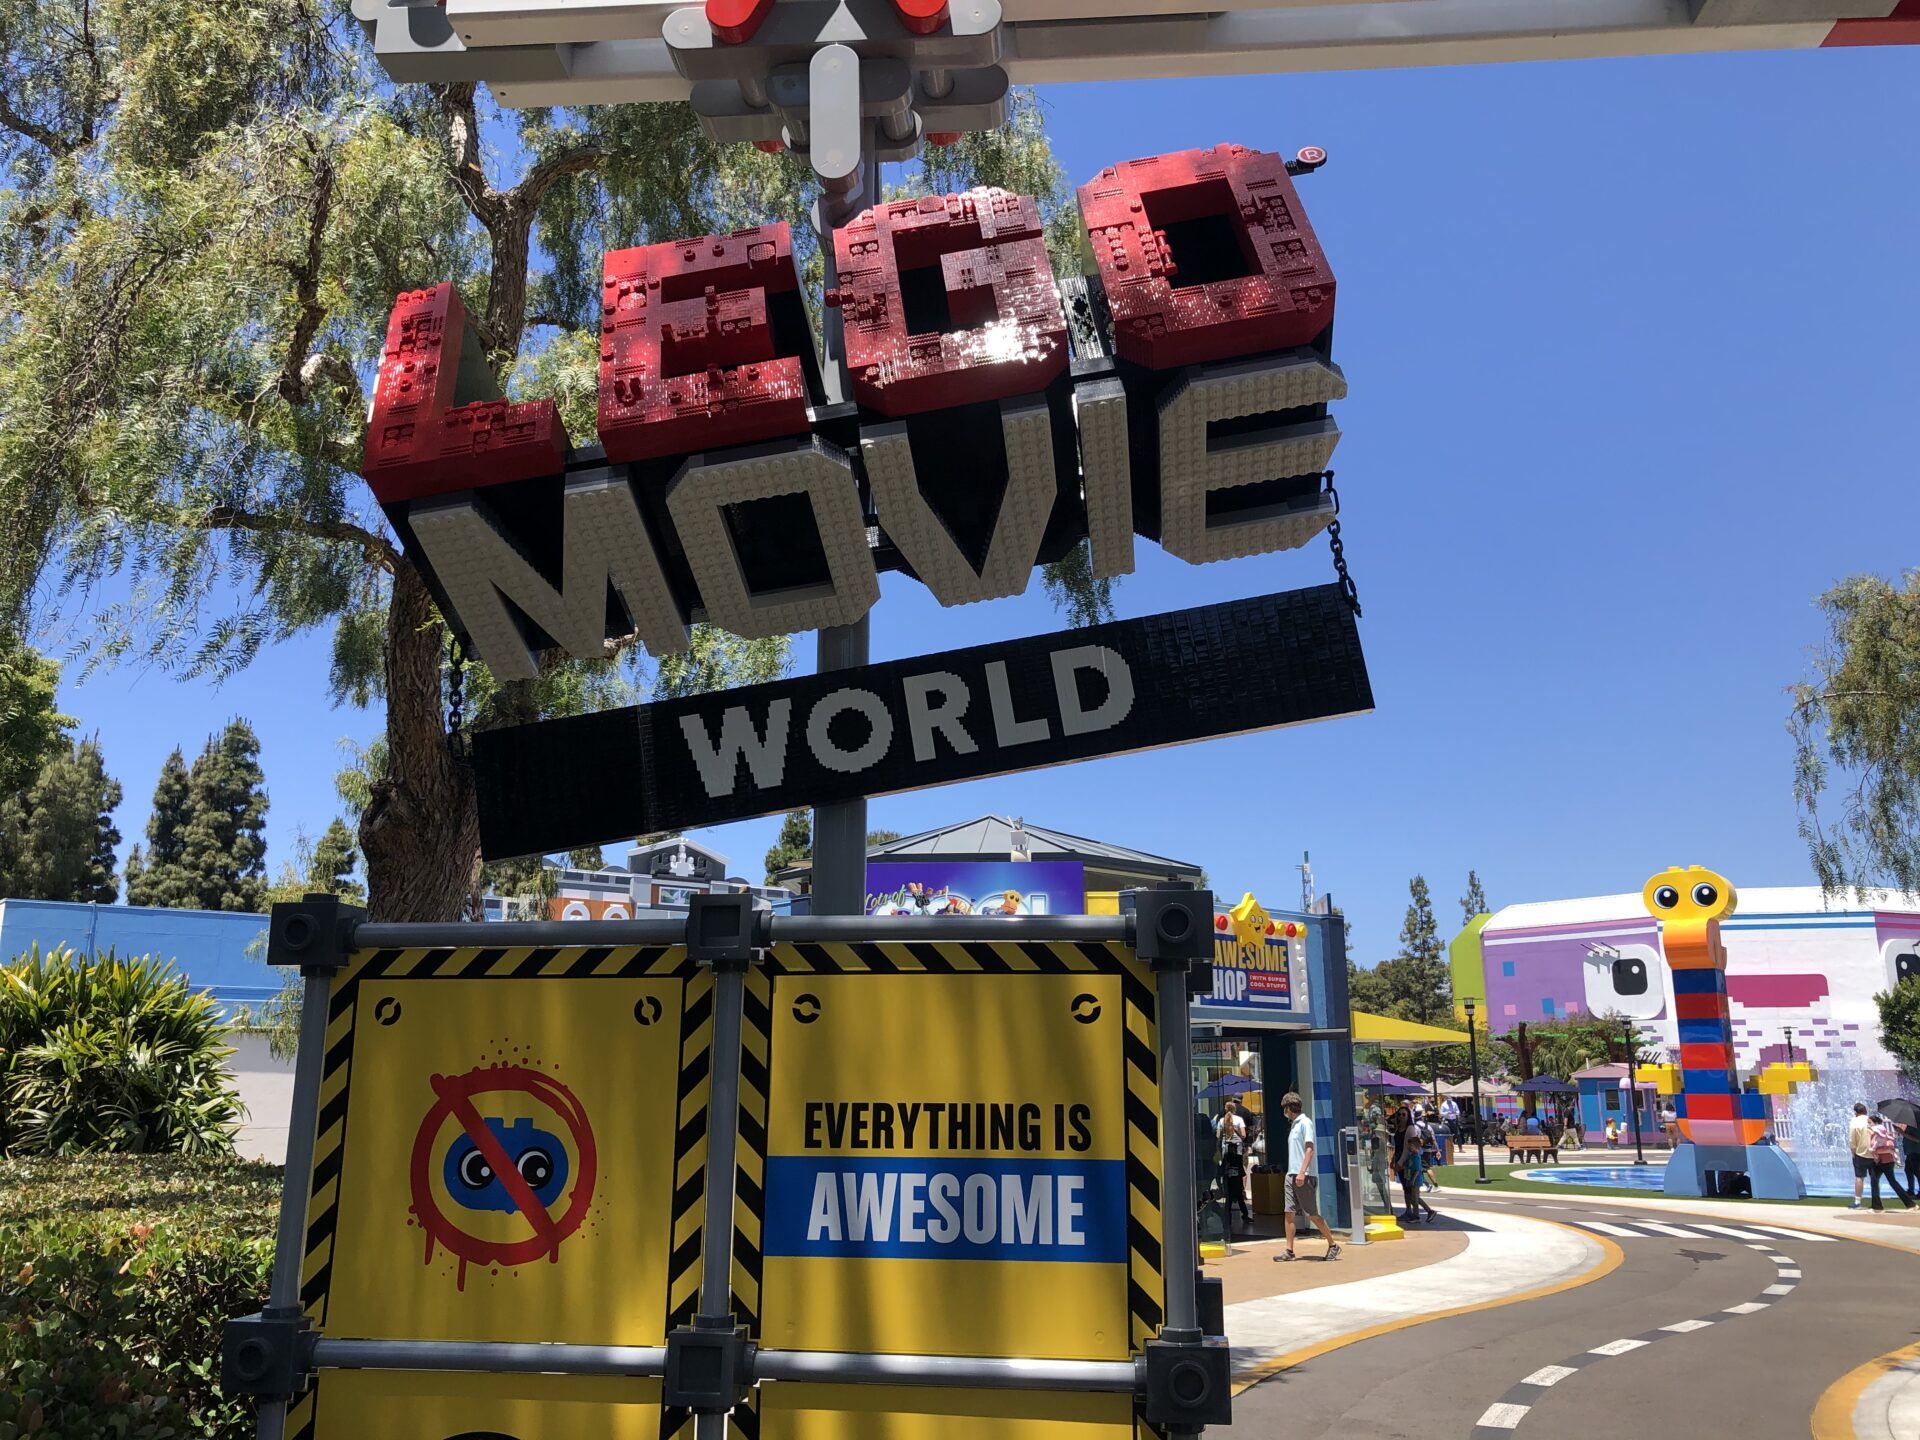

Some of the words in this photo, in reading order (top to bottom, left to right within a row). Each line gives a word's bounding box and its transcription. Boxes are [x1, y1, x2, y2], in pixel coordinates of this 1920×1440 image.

[363, 143, 1336, 502] LEGO
[408, 347, 1347, 682] MOVIE
[679, 643, 1136, 798] WORLD
[892, 883, 908, 907] of
[1203, 968, 1247, 1001] HOP
[1213, 939, 1287, 972] AWESOME
[804, 1102, 1041, 1151] EVERYTHING
[1054, 1103, 1092, 1152] IS
[806, 1171, 1086, 1246] AWESOME
